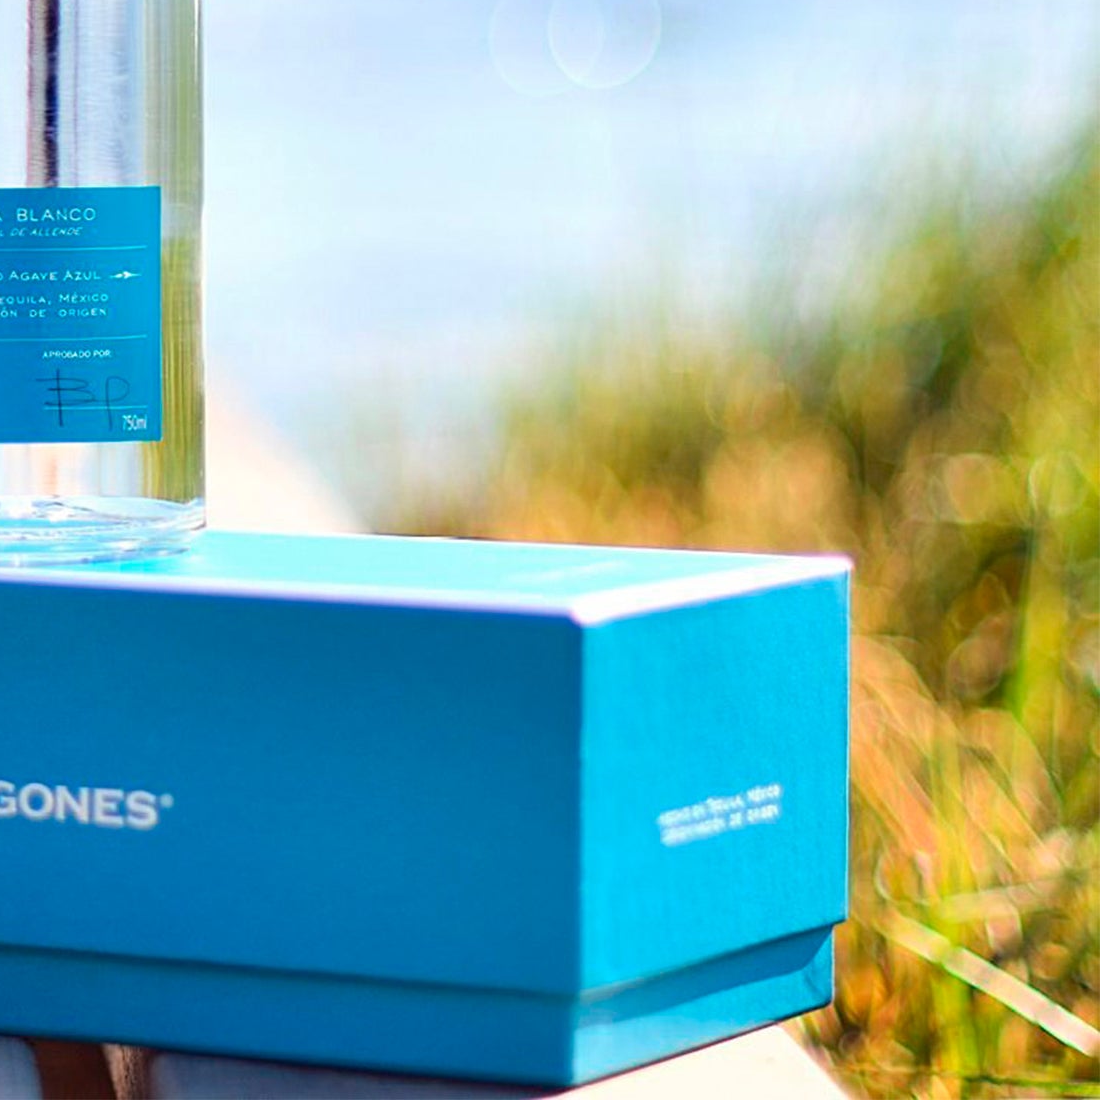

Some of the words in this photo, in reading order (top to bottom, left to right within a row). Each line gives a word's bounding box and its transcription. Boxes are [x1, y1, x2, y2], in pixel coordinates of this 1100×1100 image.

[16, 207, 97, 223] BLANCO
[10, 227, 27, 237] DE
[30, 226, 84, 237] ALLENDE
[8, 269, 58, 282] AGAVE
[62, 269, 102, 282] AZUL
[58, 292, 109, 304] MÉXICO
[28, 308, 47, 318] DE
[57, 307, 108, 318] ORIGEN
[41, 349, 91, 360] APROBADO
[121, 413, 148, 431] 750ml
